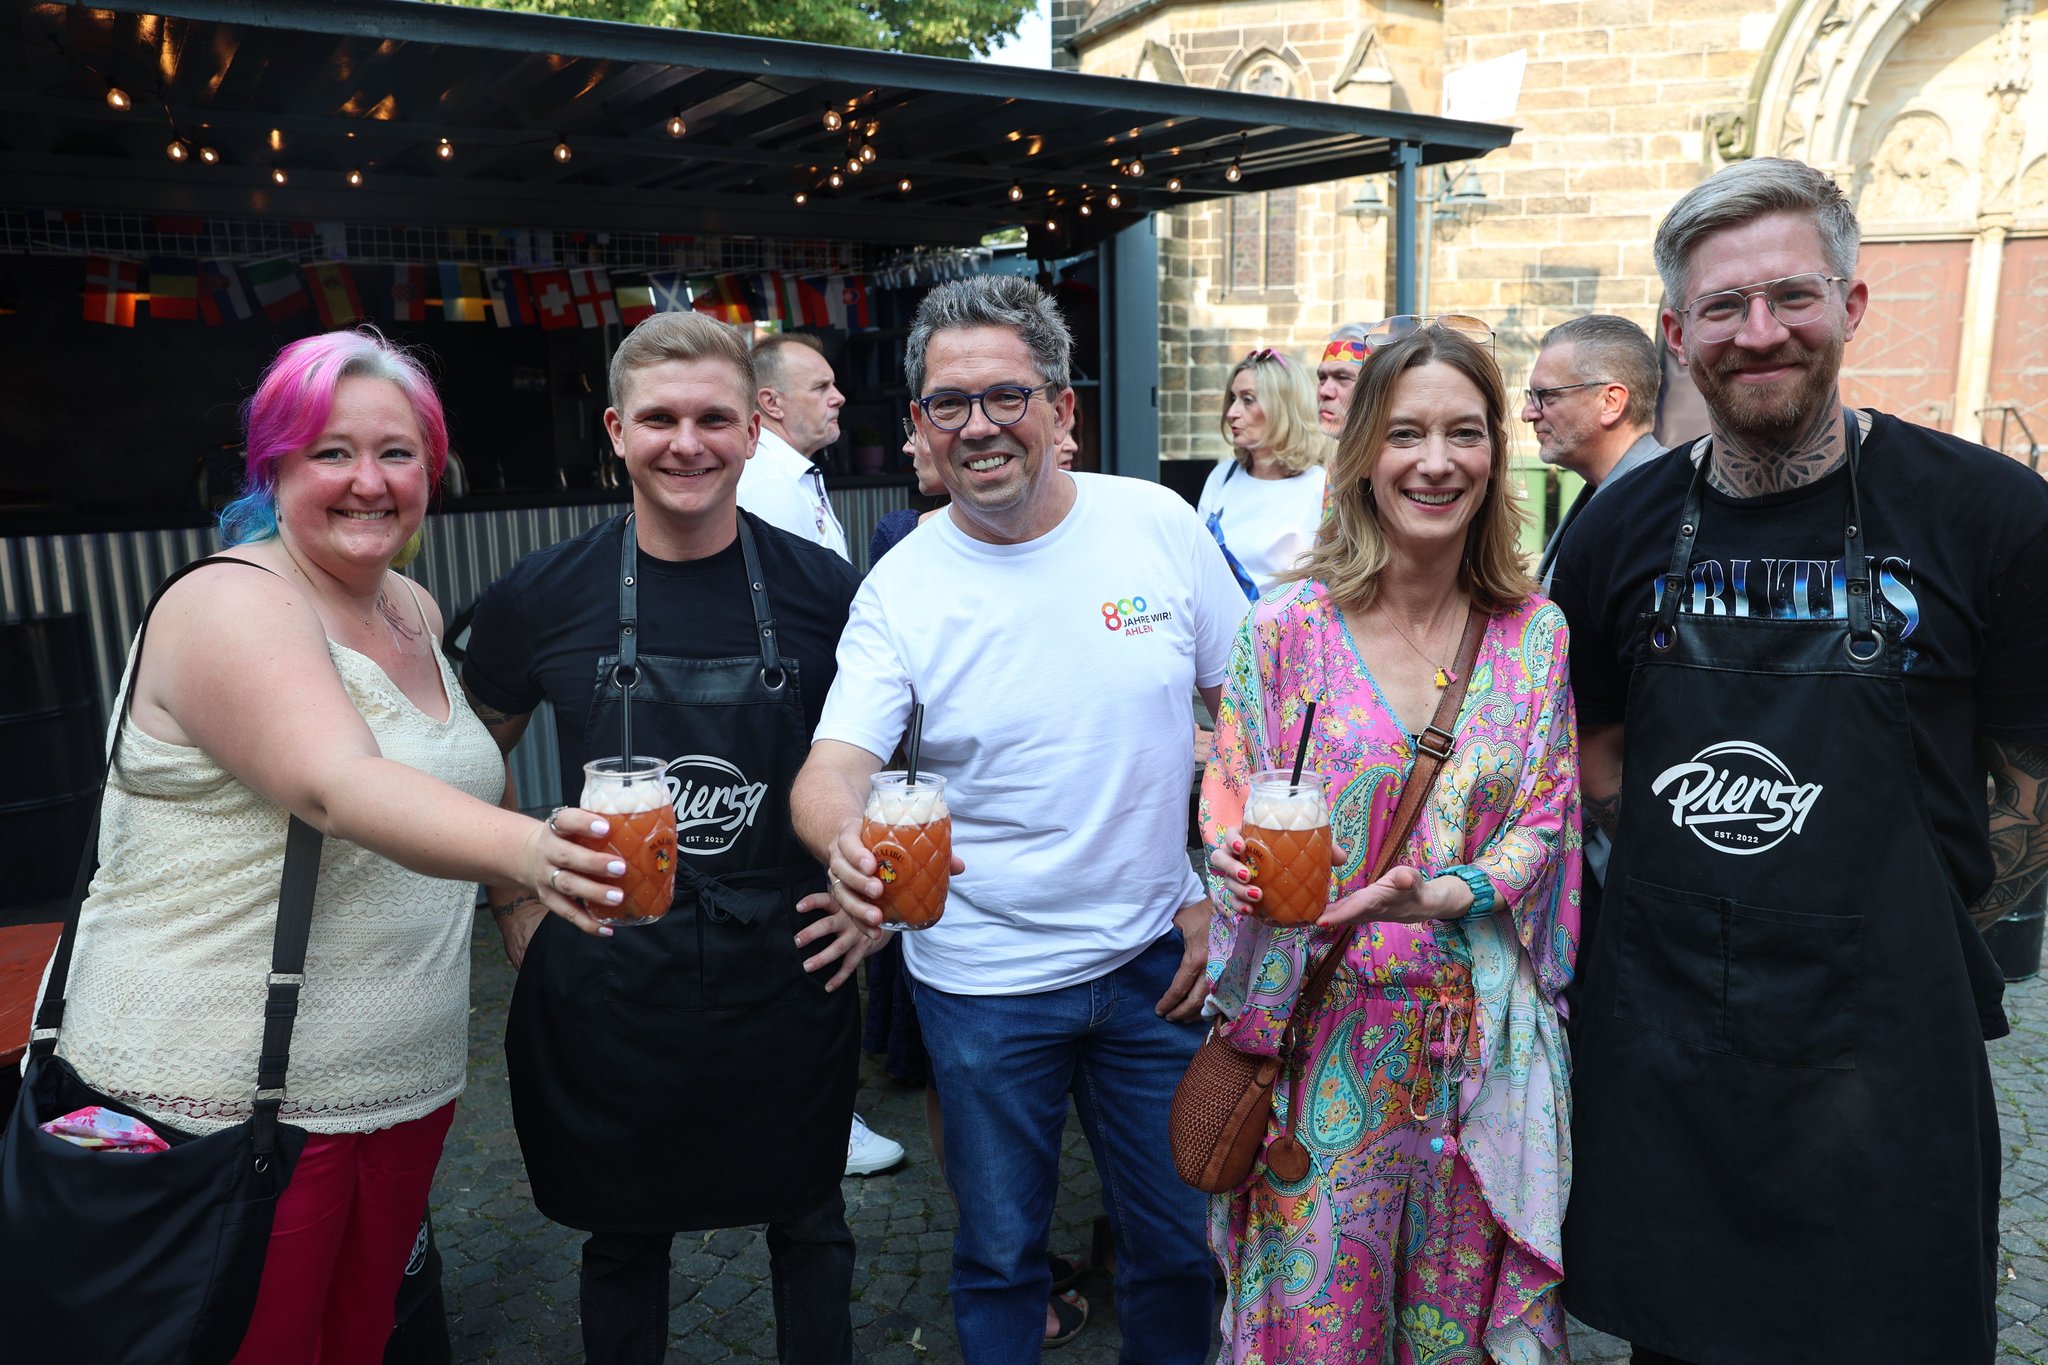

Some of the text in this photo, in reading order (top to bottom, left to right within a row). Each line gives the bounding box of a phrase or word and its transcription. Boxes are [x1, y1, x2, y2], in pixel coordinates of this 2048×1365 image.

[1101, 596, 1147, 631] 800
[1123, 611, 1172, 627] JAHRE WIR!
[1125, 625, 1153, 637] AHLEN
[1651, 762, 1823, 834] Pier59
[1714, 830, 1759, 843] EST. 2022
